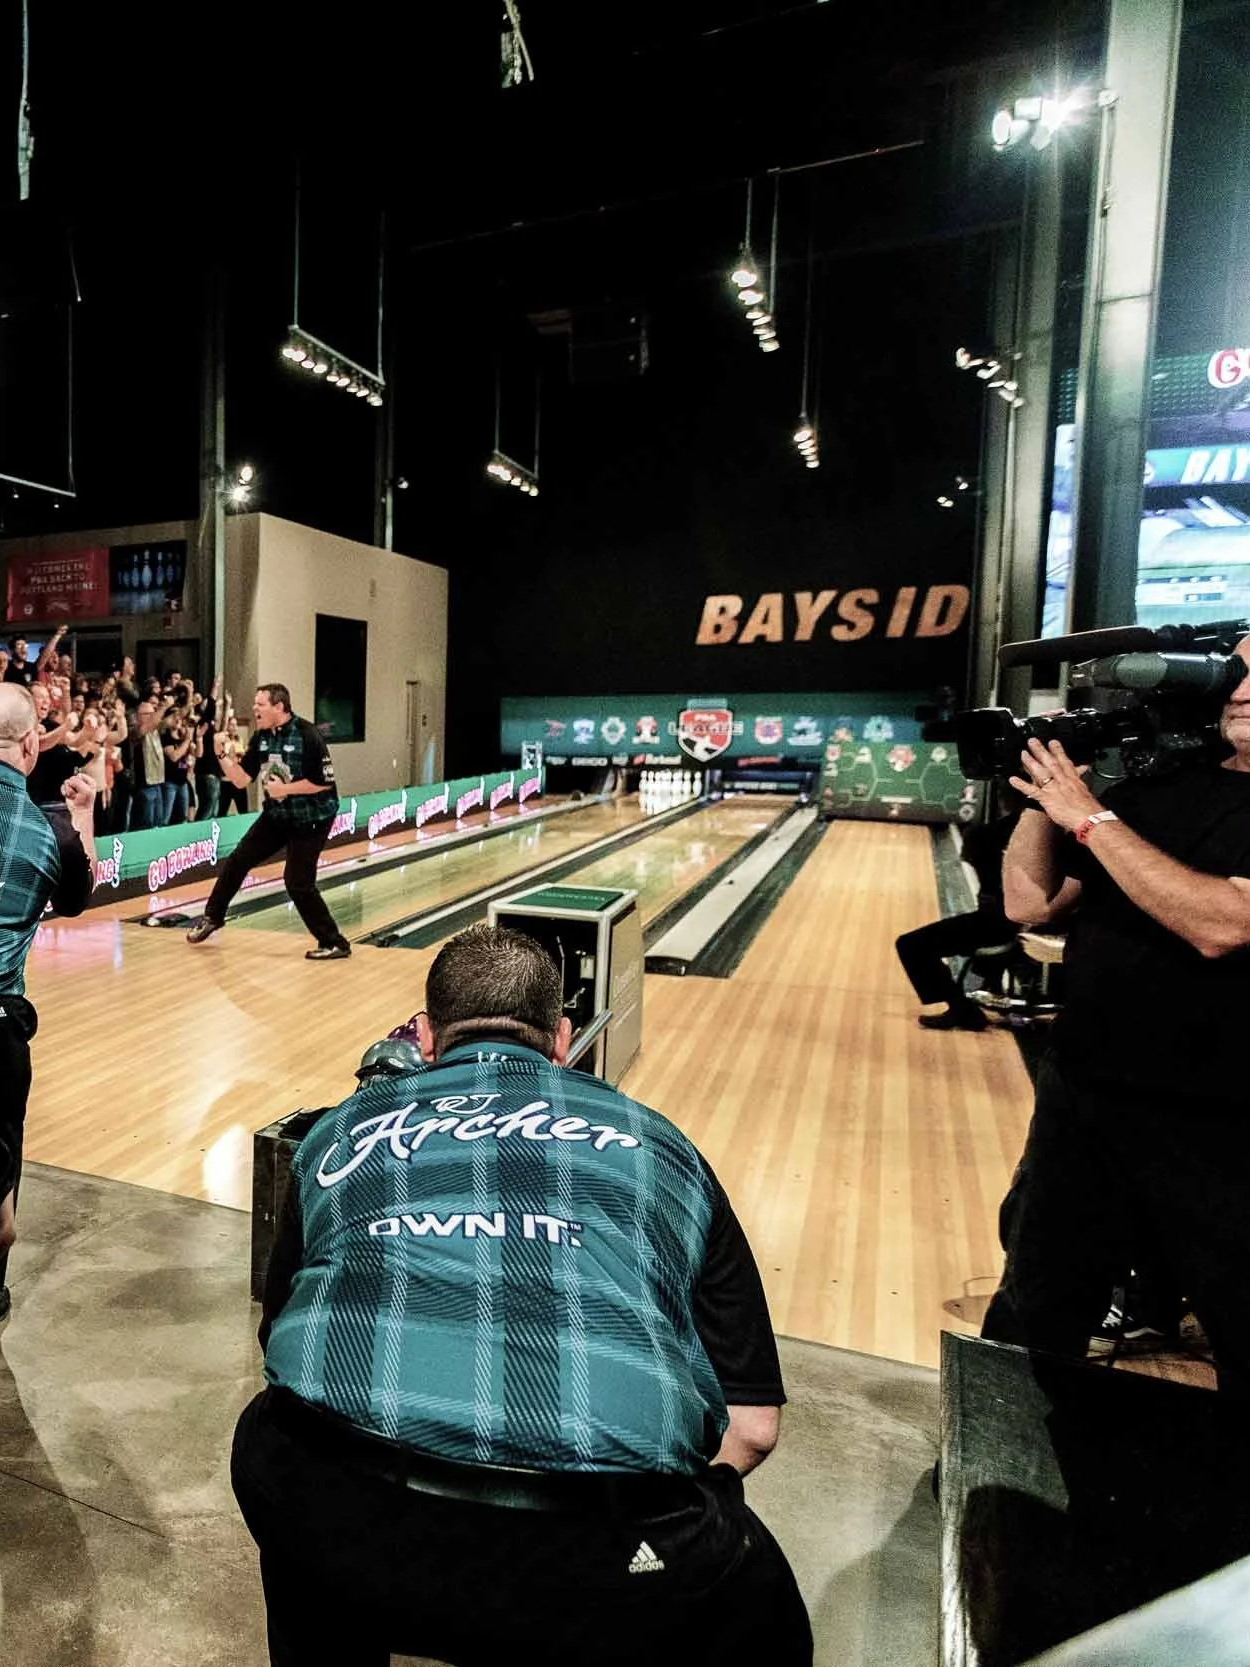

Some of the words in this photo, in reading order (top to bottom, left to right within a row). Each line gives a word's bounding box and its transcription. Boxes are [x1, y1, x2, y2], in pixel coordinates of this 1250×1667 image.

[316, 1101, 642, 1187] Archer
[368, 1213, 506, 1237] OWN
[629, 1559, 665, 1573] adidas
